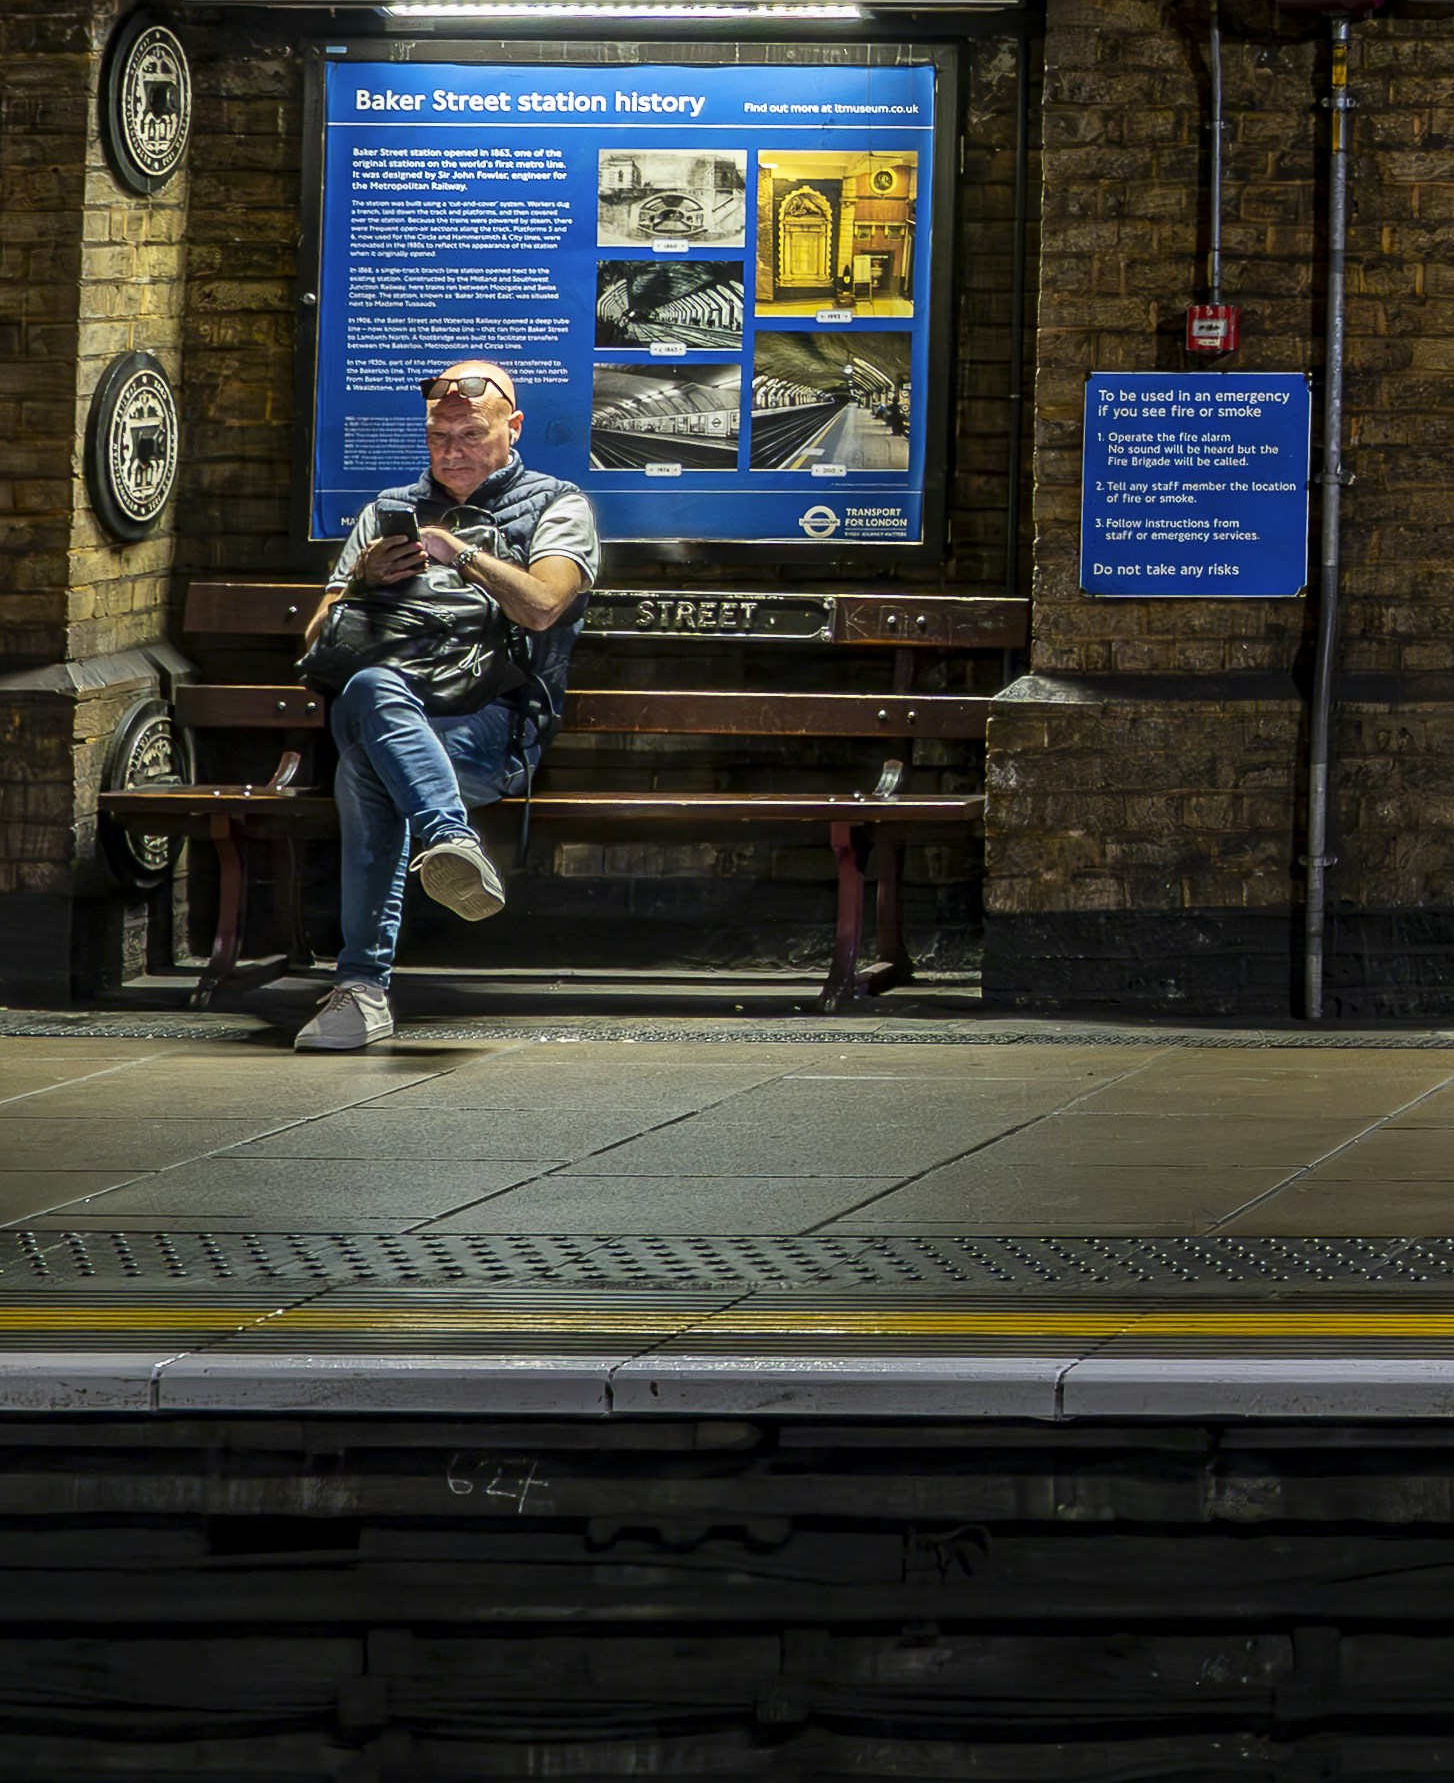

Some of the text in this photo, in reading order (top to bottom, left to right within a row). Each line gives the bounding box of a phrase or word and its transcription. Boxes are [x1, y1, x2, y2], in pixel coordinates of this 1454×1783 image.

[356, 90, 706, 117] Baker Street station history
[744, 102, 918, 113] Find out more at ltmuseum.co.uk
[353, 148, 562, 158] Baker Street station opened in 1863, one of the
[352, 159, 387, 169] original
[389, 160, 426, 168] stations
[441, 160, 458, 168] the
[458, 160, 494, 169] world's
[494, 160, 514, 169] first
[516, 161, 545, 169] metro
[546, 160, 566, 169] line.
[382, 171, 423, 180] designed
[424, 171, 436, 180] by
[438, 170, 450, 179] Sir
[452, 171, 475, 179] John
[476, 170, 510, 180] Fowler,
[511, 172, 552, 181] engineer
[552, 171, 567, 180] for
[352, 182, 468, 192] the Metropolitan Railway.
[1098, 390, 1290, 404] To be used in an emergency
[1098, 405, 1262, 420] if you see fire or smoke
[1098, 432, 1231, 443] 1. Operate the fire alarm
[1108, 444, 1278, 454] No sound will be heard but the
[1108, 456, 1248, 468] Fire Brigade will be called.
[1096, 481, 1296, 493] 2. Tell any staff member the location
[1106, 493, 1197, 503] of fire or smoke.
[845, 507, 902, 517] TRANSPORT
[845, 517, 865, 527] FOR
[866, 517, 908, 527] LONDON
[1095, 518, 1240, 528] 3. Follow instructions from
[1106, 530, 1260, 542] staff or emergency services.
[1094, 563, 1240, 578] Do not take any risks
[635, 600, 758, 629] STREET
